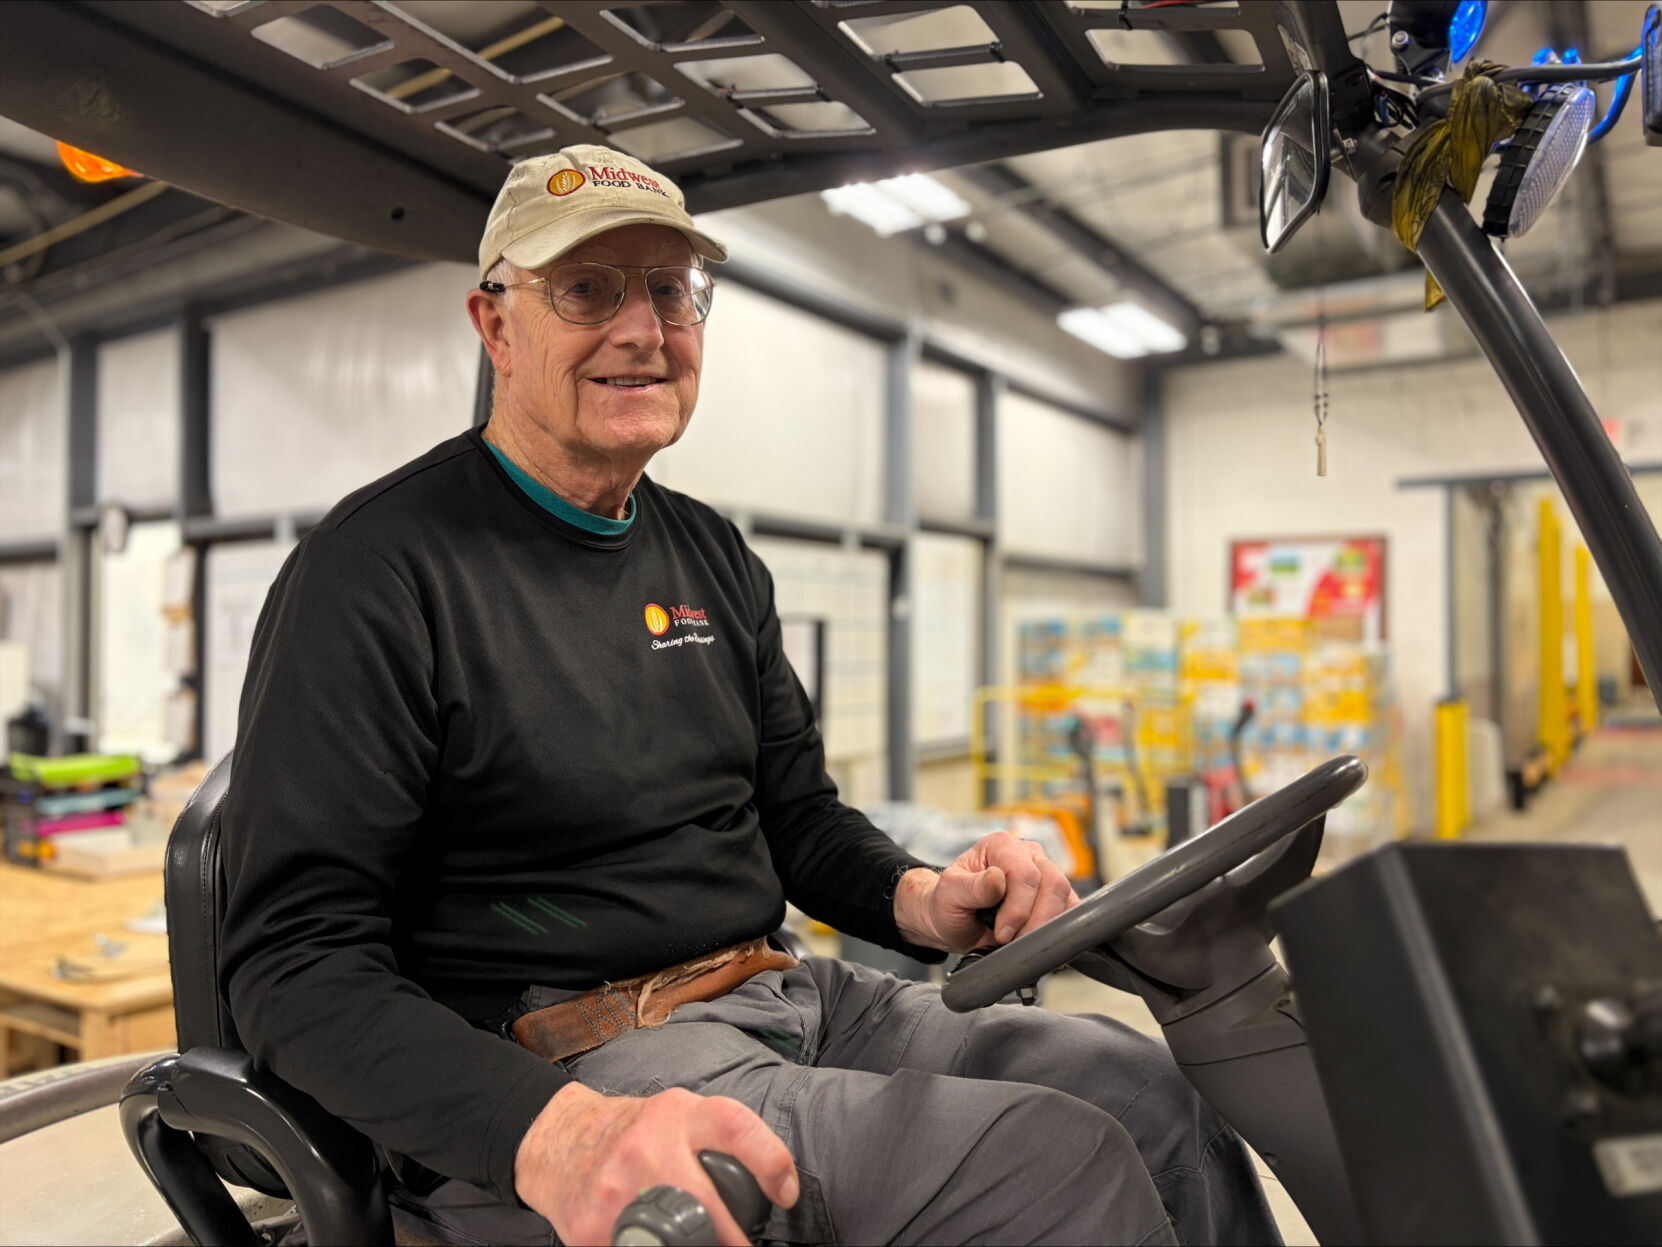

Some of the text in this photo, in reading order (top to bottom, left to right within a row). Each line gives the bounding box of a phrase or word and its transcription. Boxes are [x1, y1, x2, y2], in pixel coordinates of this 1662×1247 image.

[588, 166, 661, 189] Midwest
[592, 180, 670, 198] FOOD BANK
[651, 637, 683, 650] Sharing
